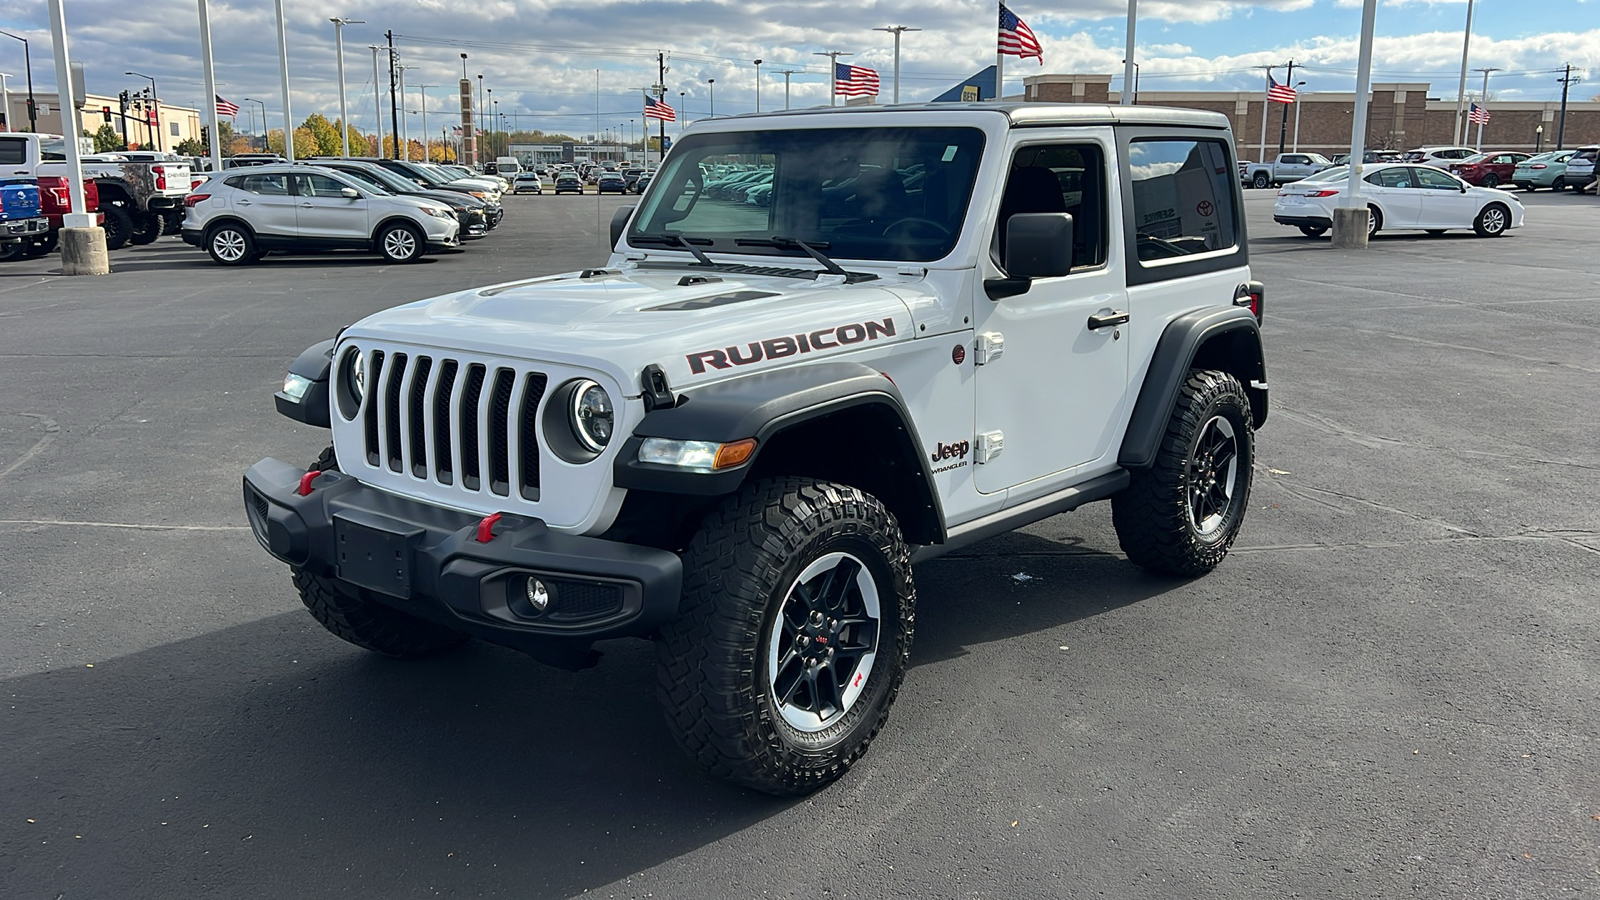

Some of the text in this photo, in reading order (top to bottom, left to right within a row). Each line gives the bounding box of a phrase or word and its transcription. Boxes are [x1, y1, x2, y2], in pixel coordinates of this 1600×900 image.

[963, 91, 977, 102] BEST
[686, 317, 896, 375] RUBICON
[931, 440, 970, 463] Jeep
[931, 460, 968, 475] WRANGLER
[815, 635, 828, 644] Jeep
